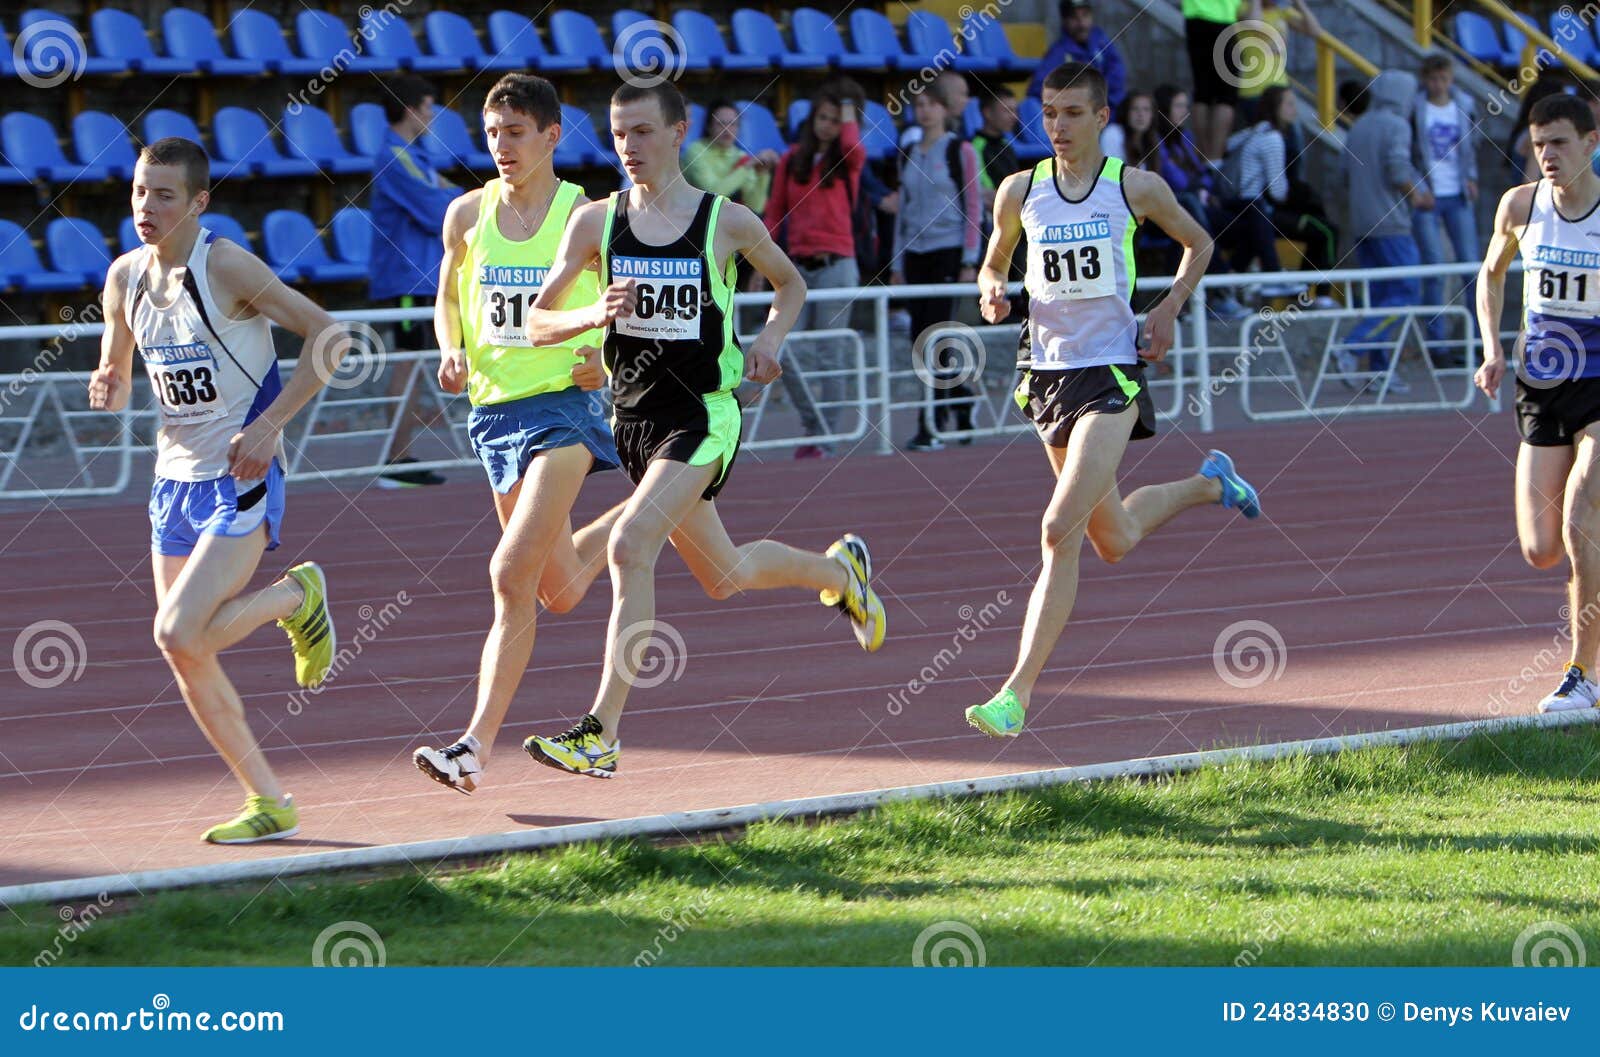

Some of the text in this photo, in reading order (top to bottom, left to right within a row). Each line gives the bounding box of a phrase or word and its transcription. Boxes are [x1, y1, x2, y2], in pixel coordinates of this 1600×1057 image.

[612, 258, 700, 276] SAMSUNG
[1042, 245, 1102, 283] 813
[1532, 247, 1600, 267] SAMSUN
[480, 267, 549, 284] SAMSUN
[1539, 268, 1588, 302] 611
[490, 292, 539, 328] 31
[153, 366, 217, 406] 1633
